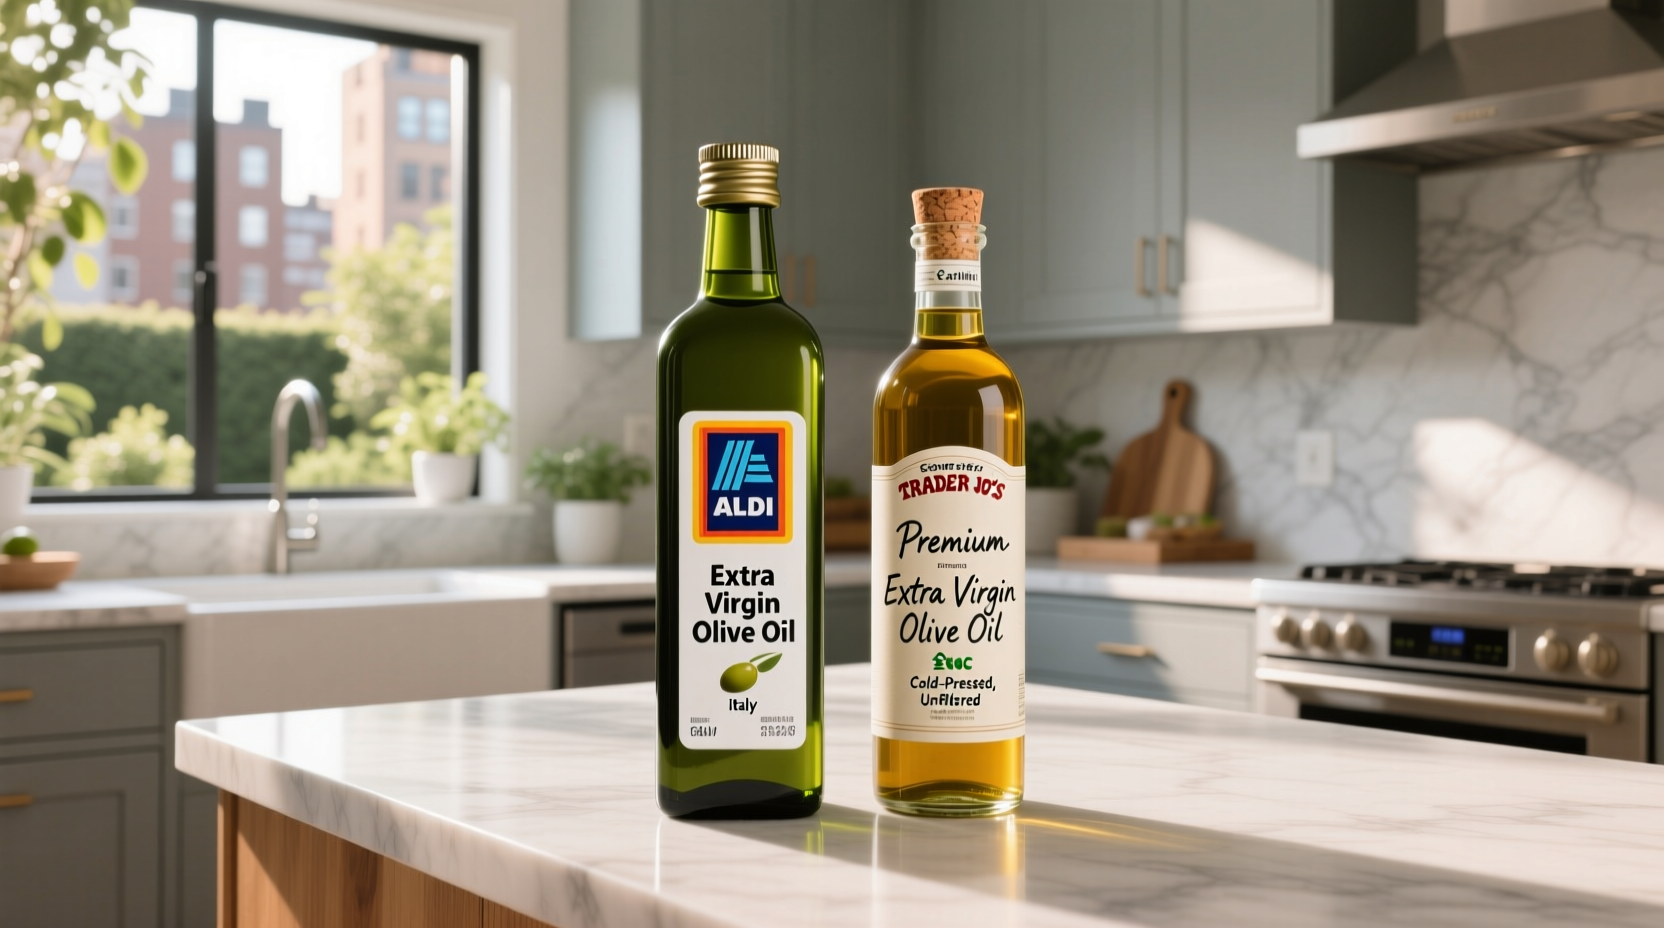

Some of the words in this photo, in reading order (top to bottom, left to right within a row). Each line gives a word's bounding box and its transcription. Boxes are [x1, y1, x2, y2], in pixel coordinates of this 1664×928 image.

[898, 474, 970, 501] TRADER
[973, 476, 1006, 501] JO'S
[712, 496, 774, 517] ALDI
[896, 519, 1010, 560] Premium
[710, 564, 775, 586] Extra
[704, 591, 780, 620] Virgin
[884, 573, 946, 606] Extra
[954, 574, 1016, 617] Virgin
[692, 619, 756, 644] Olive
[761, 618, 795, 643] Oil
[899, 611, 960, 644] Olive
[967, 611, 1003, 644] Oil
[910, 675, 996, 692] Cold-Pressed,
[728, 697, 758, 715] Italy
